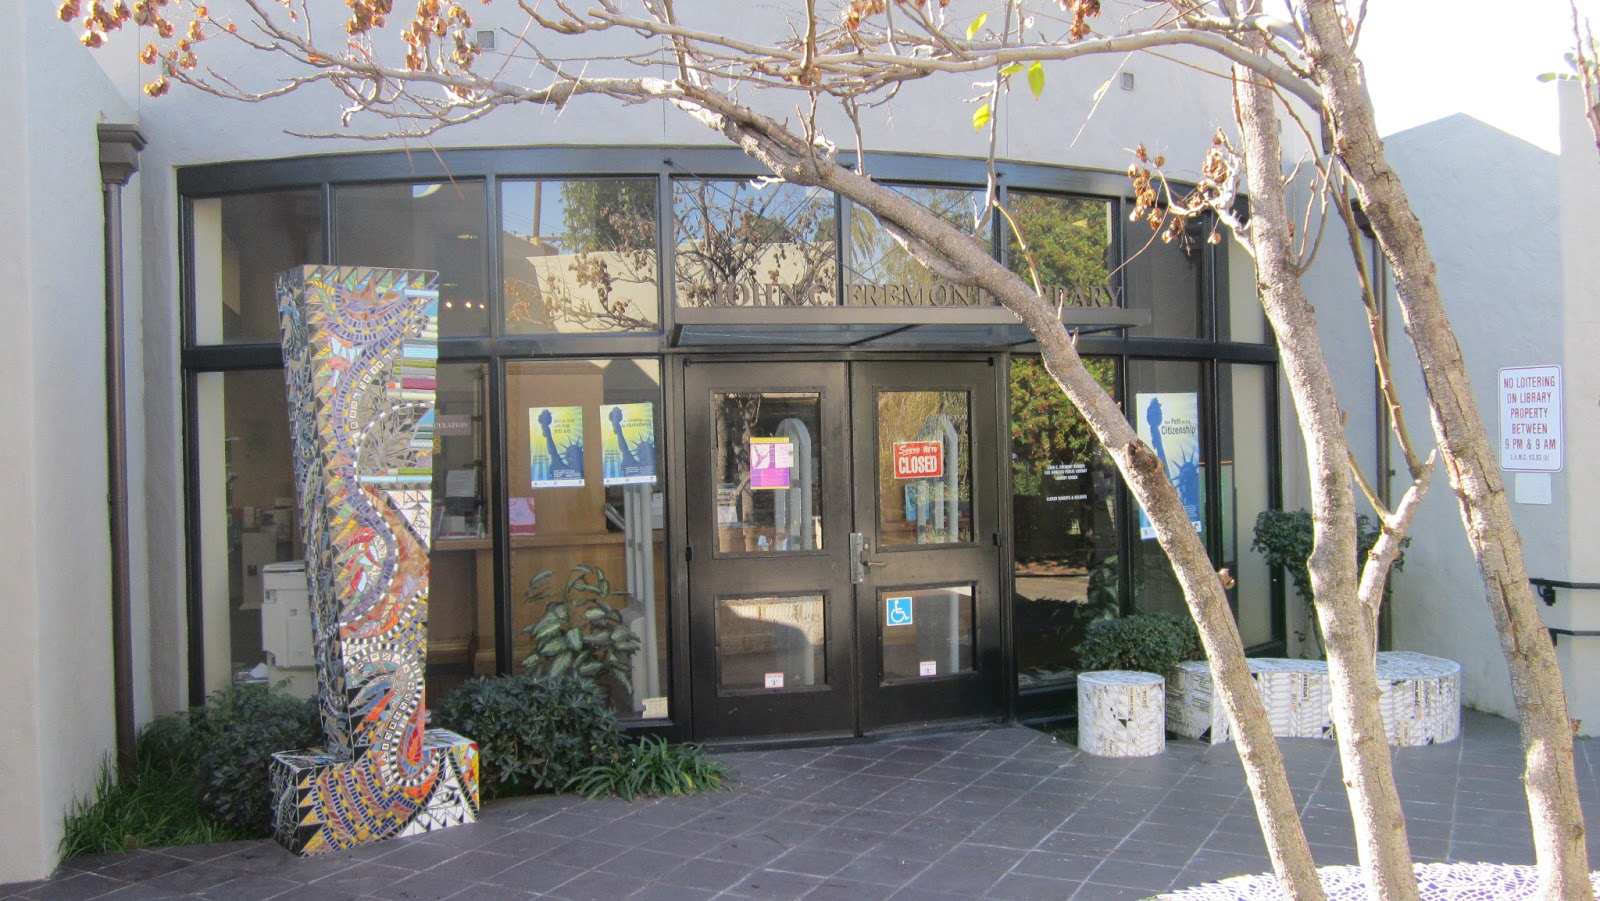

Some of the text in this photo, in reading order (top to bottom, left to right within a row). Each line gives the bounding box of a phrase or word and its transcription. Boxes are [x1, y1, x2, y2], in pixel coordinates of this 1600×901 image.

[711, 282, 798, 308] JOHN
[1503, 376, 1555, 388] NO LOITERING
[1507, 391, 1552, 404] ON LIBRARY
[1510, 407, 1549, 419] PROPERTY
[1161, 424, 1196, 436] Citizenship
[1511, 423, 1548, 435] BETWEEN
[1505, 439, 1557, 449] 9 PM & 9 AM
[898, 456, 938, 474] CLOSED
